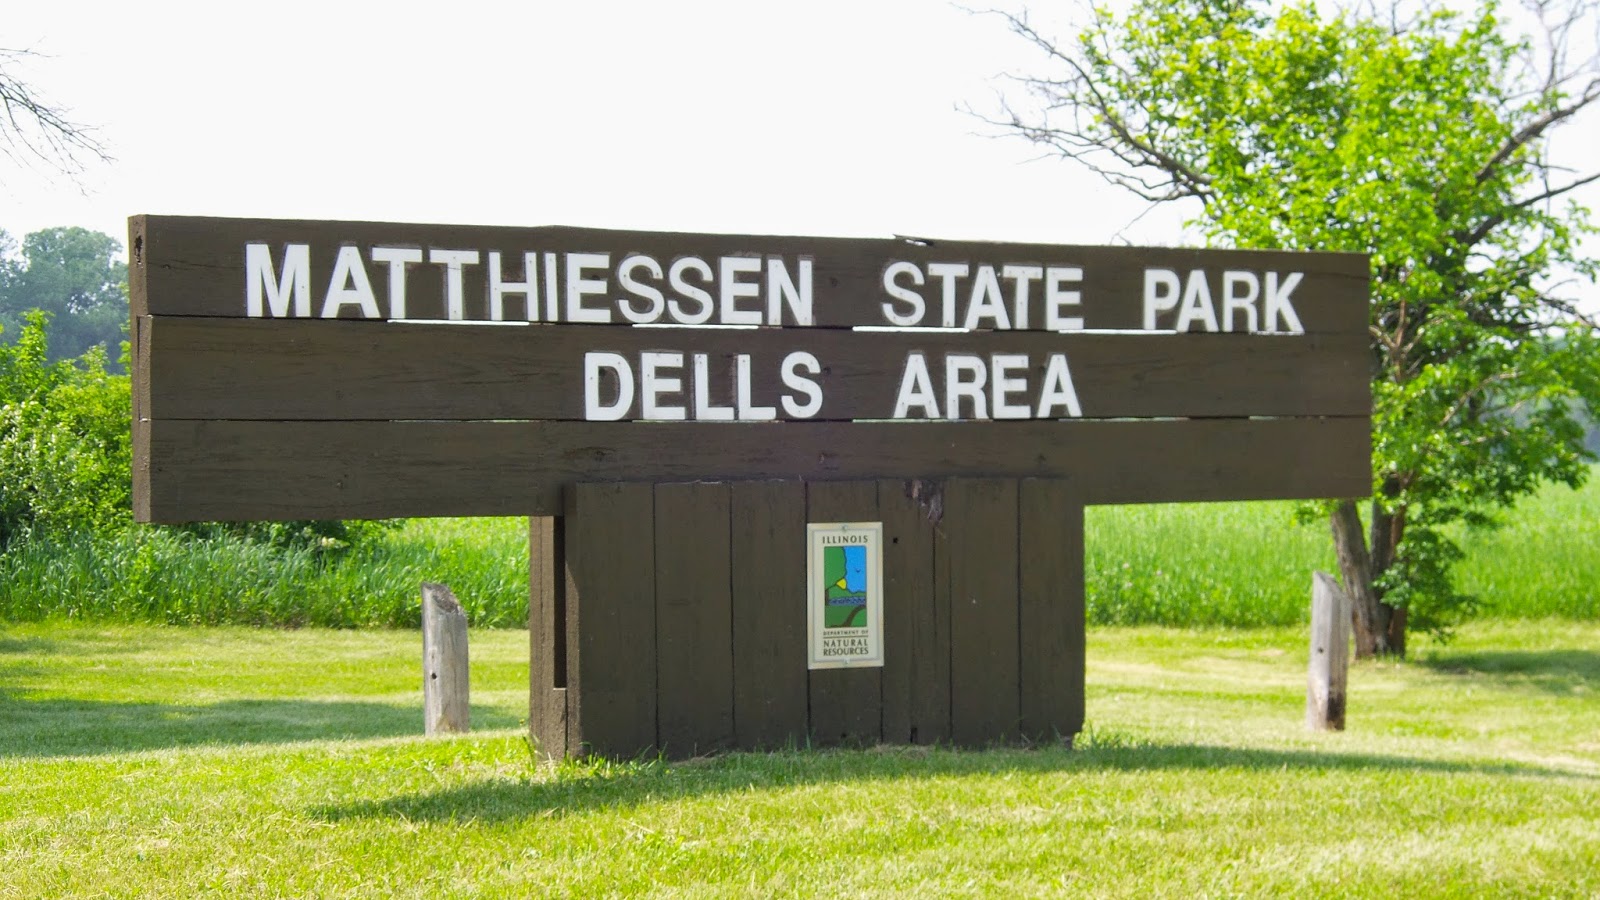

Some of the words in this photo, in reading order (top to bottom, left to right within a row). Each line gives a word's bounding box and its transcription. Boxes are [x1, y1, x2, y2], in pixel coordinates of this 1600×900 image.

[245, 243, 813, 326] MATTHIESSEN
[881, 261, 1084, 331] STATE
[1143, 268, 1305, 335] PARK
[584, 351, 824, 421] DELLS
[893, 353, 1083, 419] AREA
[822, 535, 868, 544] ILLINOIS
[823, 639, 868, 648] NATURAL
[823, 647, 869, 656] RESOURCES
